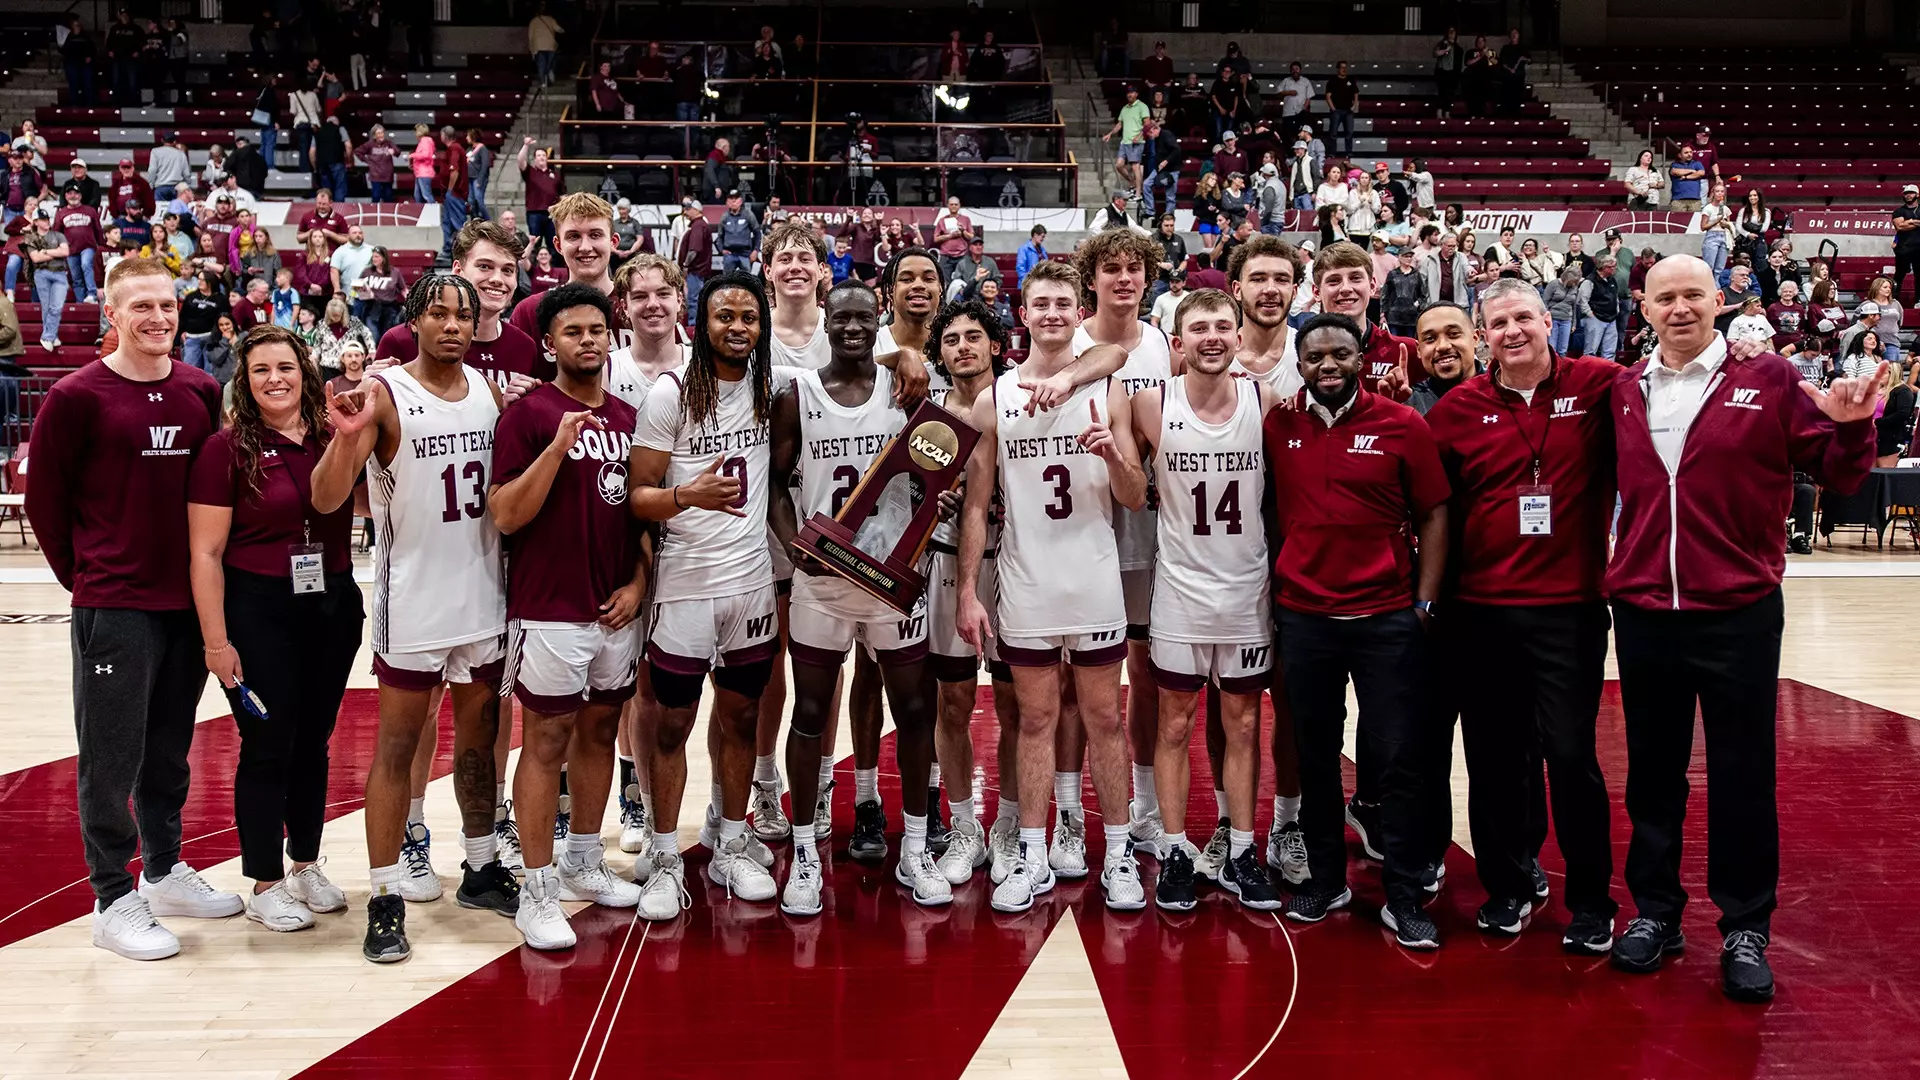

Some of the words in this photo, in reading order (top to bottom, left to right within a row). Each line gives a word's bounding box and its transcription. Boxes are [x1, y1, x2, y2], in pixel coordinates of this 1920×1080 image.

[1465, 214, 1533, 230] MOTION
[1808, 219, 1828, 229] ON,
[1834, 220, 1849, 229] ON
[1854, 220, 1896, 230] BUFFA
[370, 275, 392, 290] WT
[1371, 362, 1394, 375] WT
[1553, 396, 1578, 413] WT
[1732, 387, 1761, 403] WT
[148, 425, 183, 449] WT
[411, 433, 456, 459] WEST
[459, 430, 495, 453] TEXA
[567, 429, 631, 463] SQUA
[688, 432, 731, 455] WEST
[808, 436, 850, 460] WEST
[854, 432, 901, 456] TEX
[1005, 437, 1048, 460] WEST
[1052, 434, 1090, 455] TEX
[1353, 434, 1379, 449] WT
[910, 435, 954, 467] NCAA
[1165, 452, 1209, 472] WEST
[1214, 450, 1260, 472] TEXAS
[441, 460, 486, 523] 13
[1042, 464, 1073, 520] 3
[1191, 479, 1243, 536] 14
[823, 541, 859, 567] REGIONAL
[856, 562, 895, 589] CHAMPION
[746, 611, 775, 640] WT
[898, 614, 925, 641] WT
[1241, 644, 1271, 669] WT
